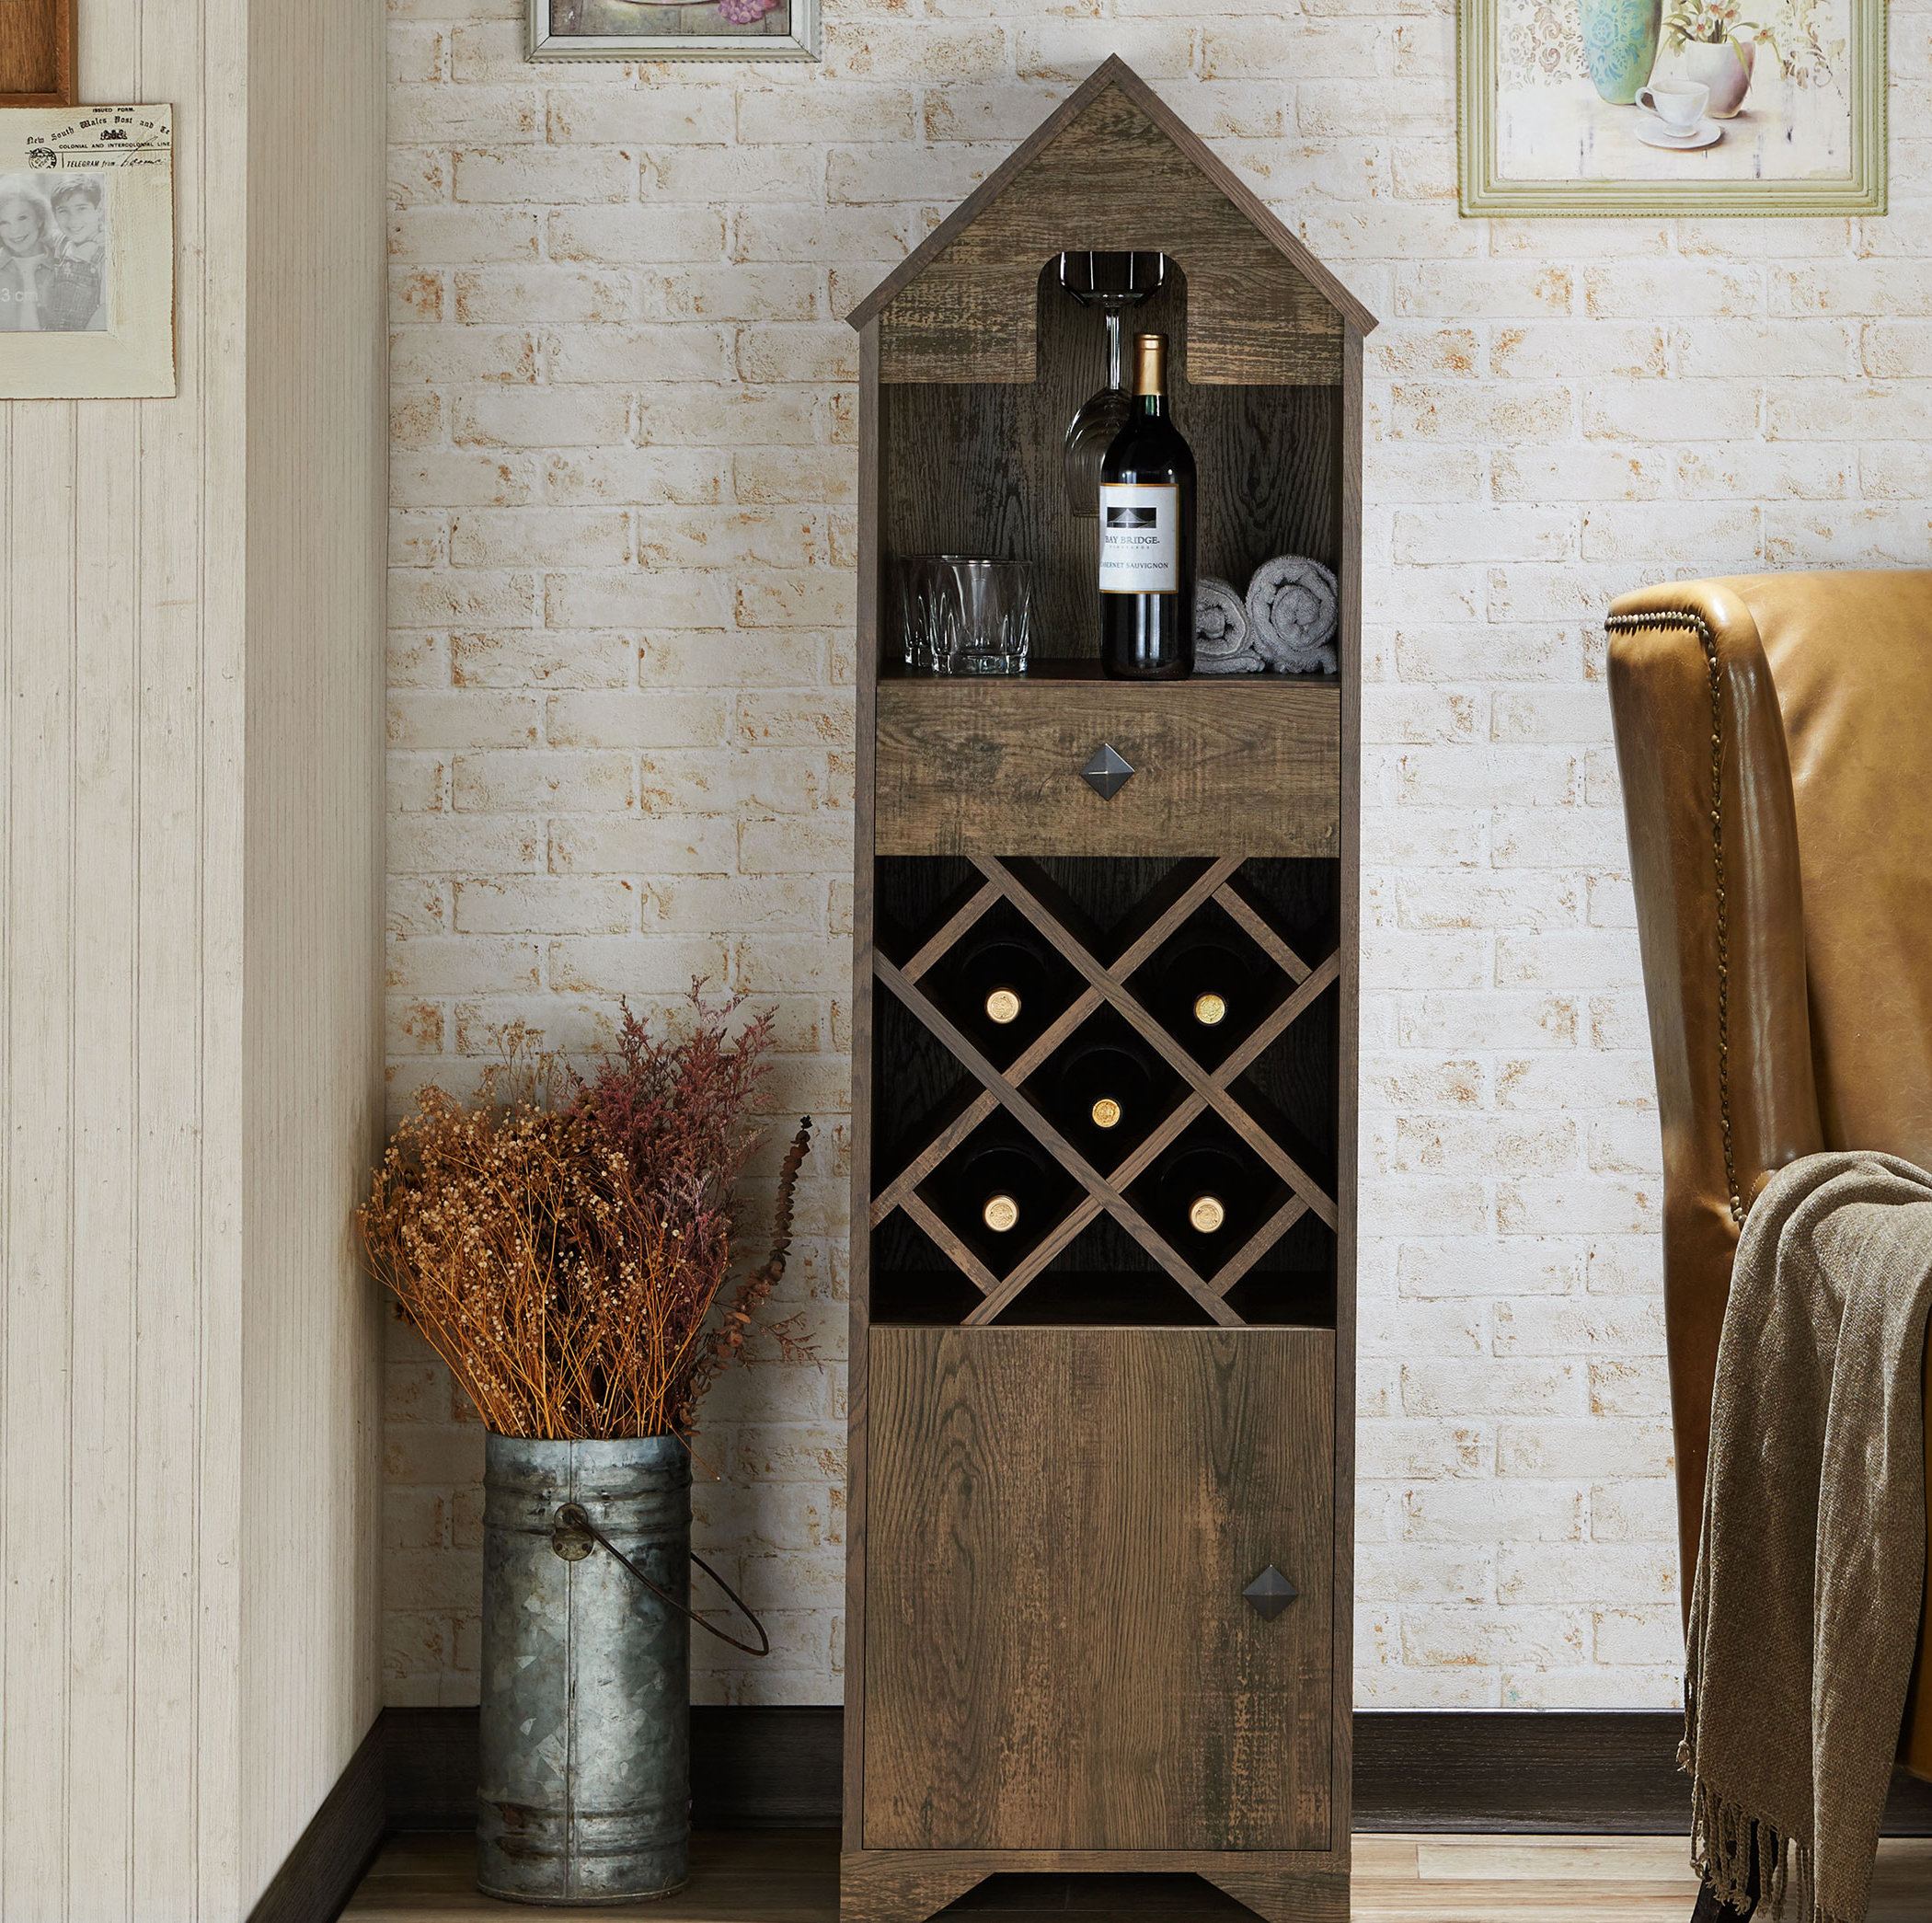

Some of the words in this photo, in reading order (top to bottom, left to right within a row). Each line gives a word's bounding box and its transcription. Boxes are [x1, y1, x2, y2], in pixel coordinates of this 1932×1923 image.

[27, 136, 45, 145] New
[51, 127, 75, 141] South
[80, 117, 108, 130] Wales
[114, 116, 132, 124] Post
[139, 120, 155, 130] and
[66, 160, 99, 168] TELEGRAM
[101, 160, 116, 168] from
[1105, 535, 1119, 544] BAY
